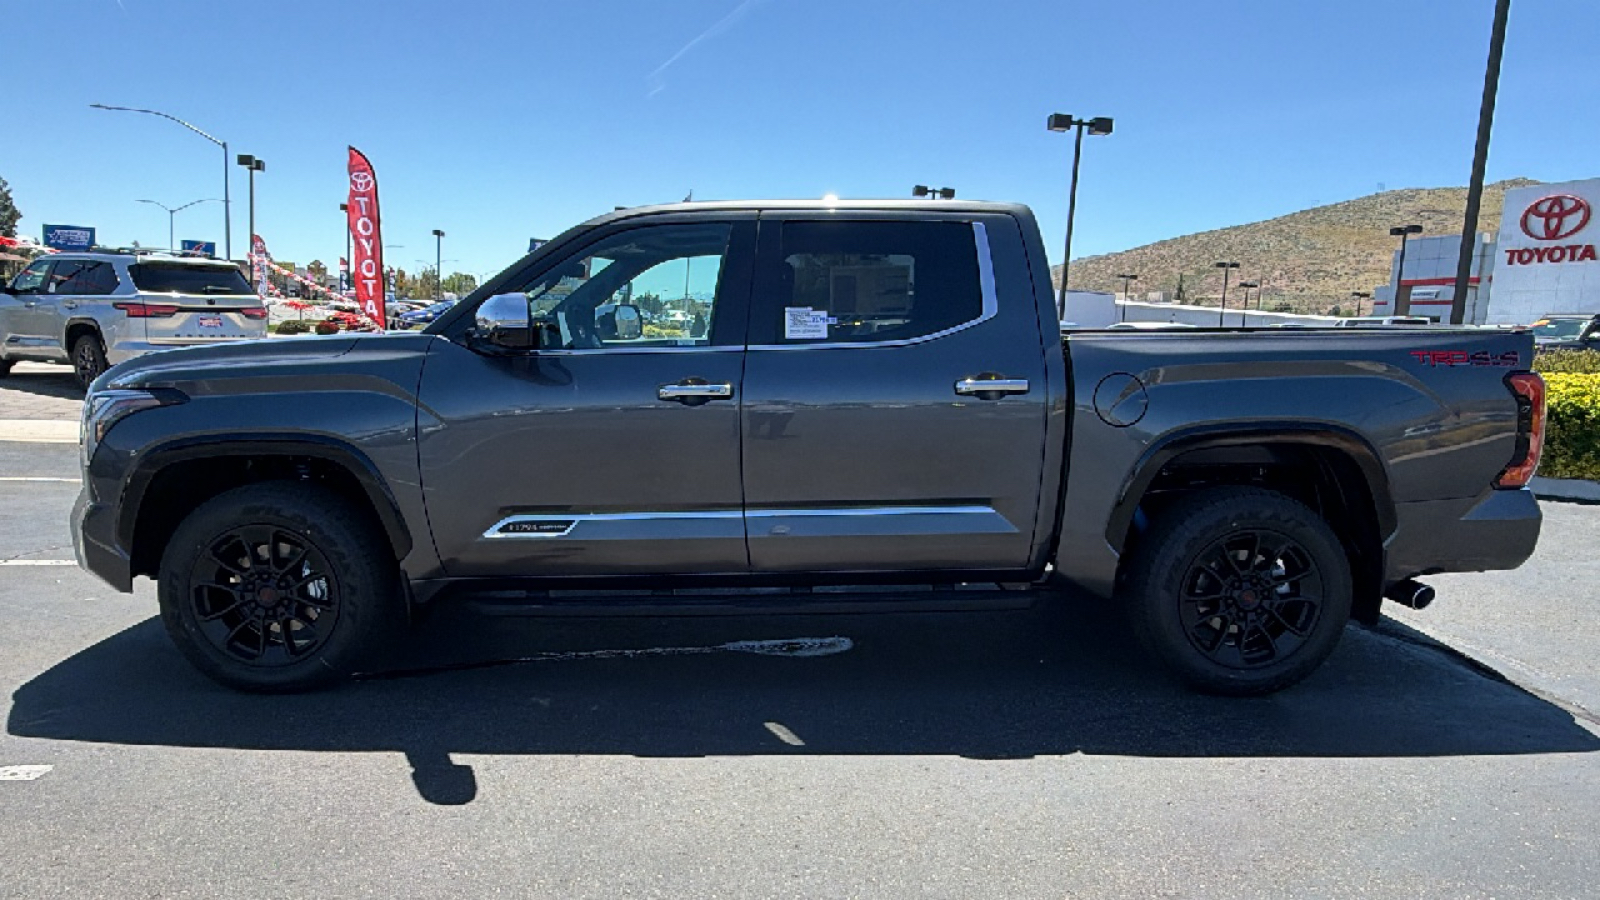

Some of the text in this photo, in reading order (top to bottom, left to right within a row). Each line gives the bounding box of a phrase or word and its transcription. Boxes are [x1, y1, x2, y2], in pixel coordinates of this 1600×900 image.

[354, 196, 379, 317] TOYOTA
[1504, 244, 1597, 266] TOYOTA
[1409, 350, 1470, 367] TRD
